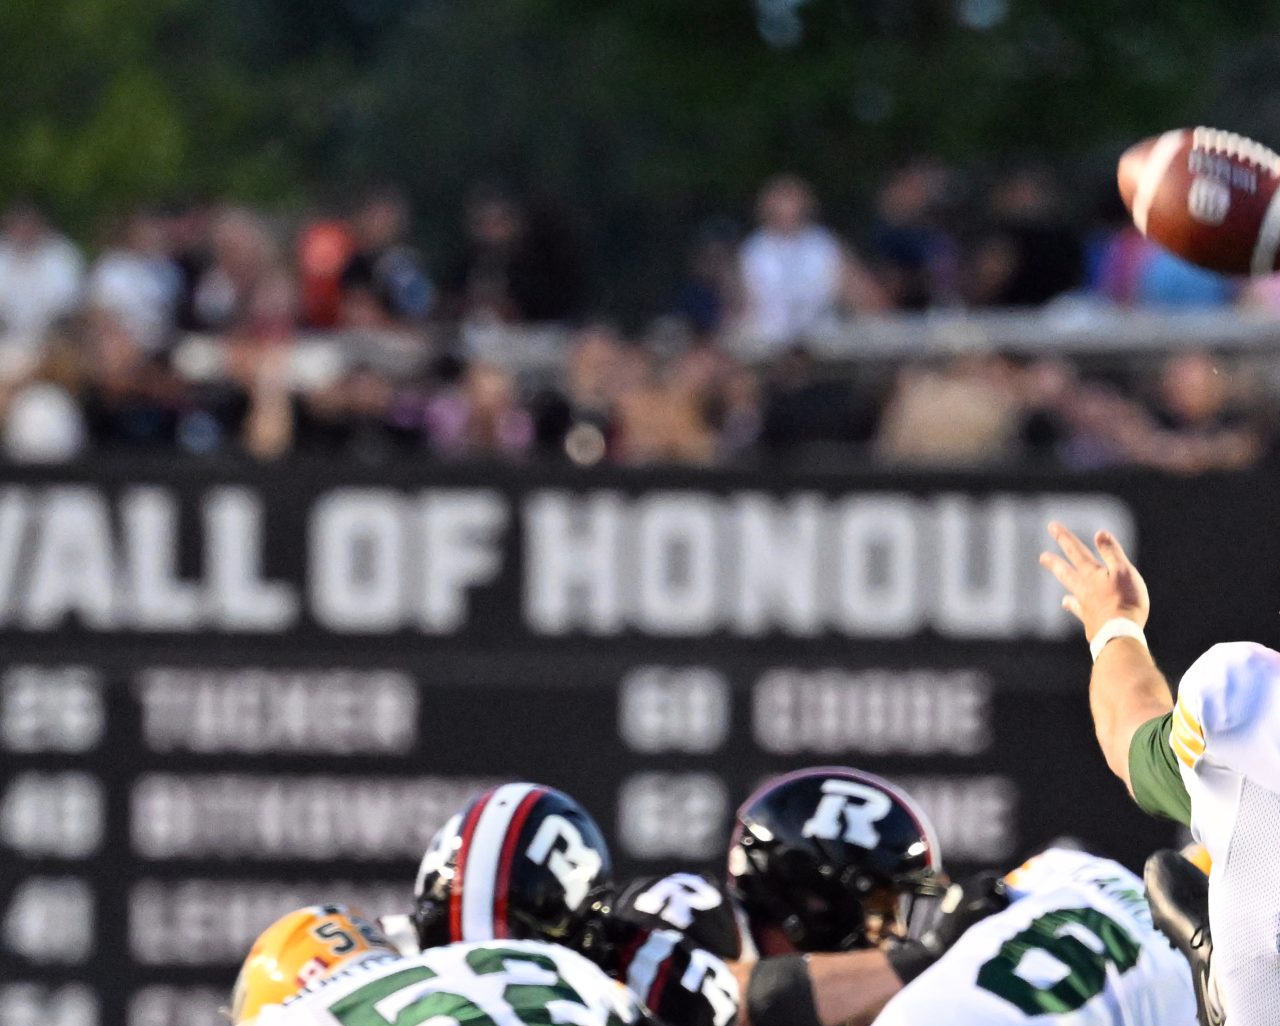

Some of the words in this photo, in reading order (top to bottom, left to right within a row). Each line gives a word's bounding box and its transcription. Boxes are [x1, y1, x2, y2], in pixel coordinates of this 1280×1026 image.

[0, 487, 297, 633] ALL
[308, 487, 508, 635] OF
[802, 779, 893, 850] R
[526, 815, 602, 911] R
[634, 871, 722, 931] R
